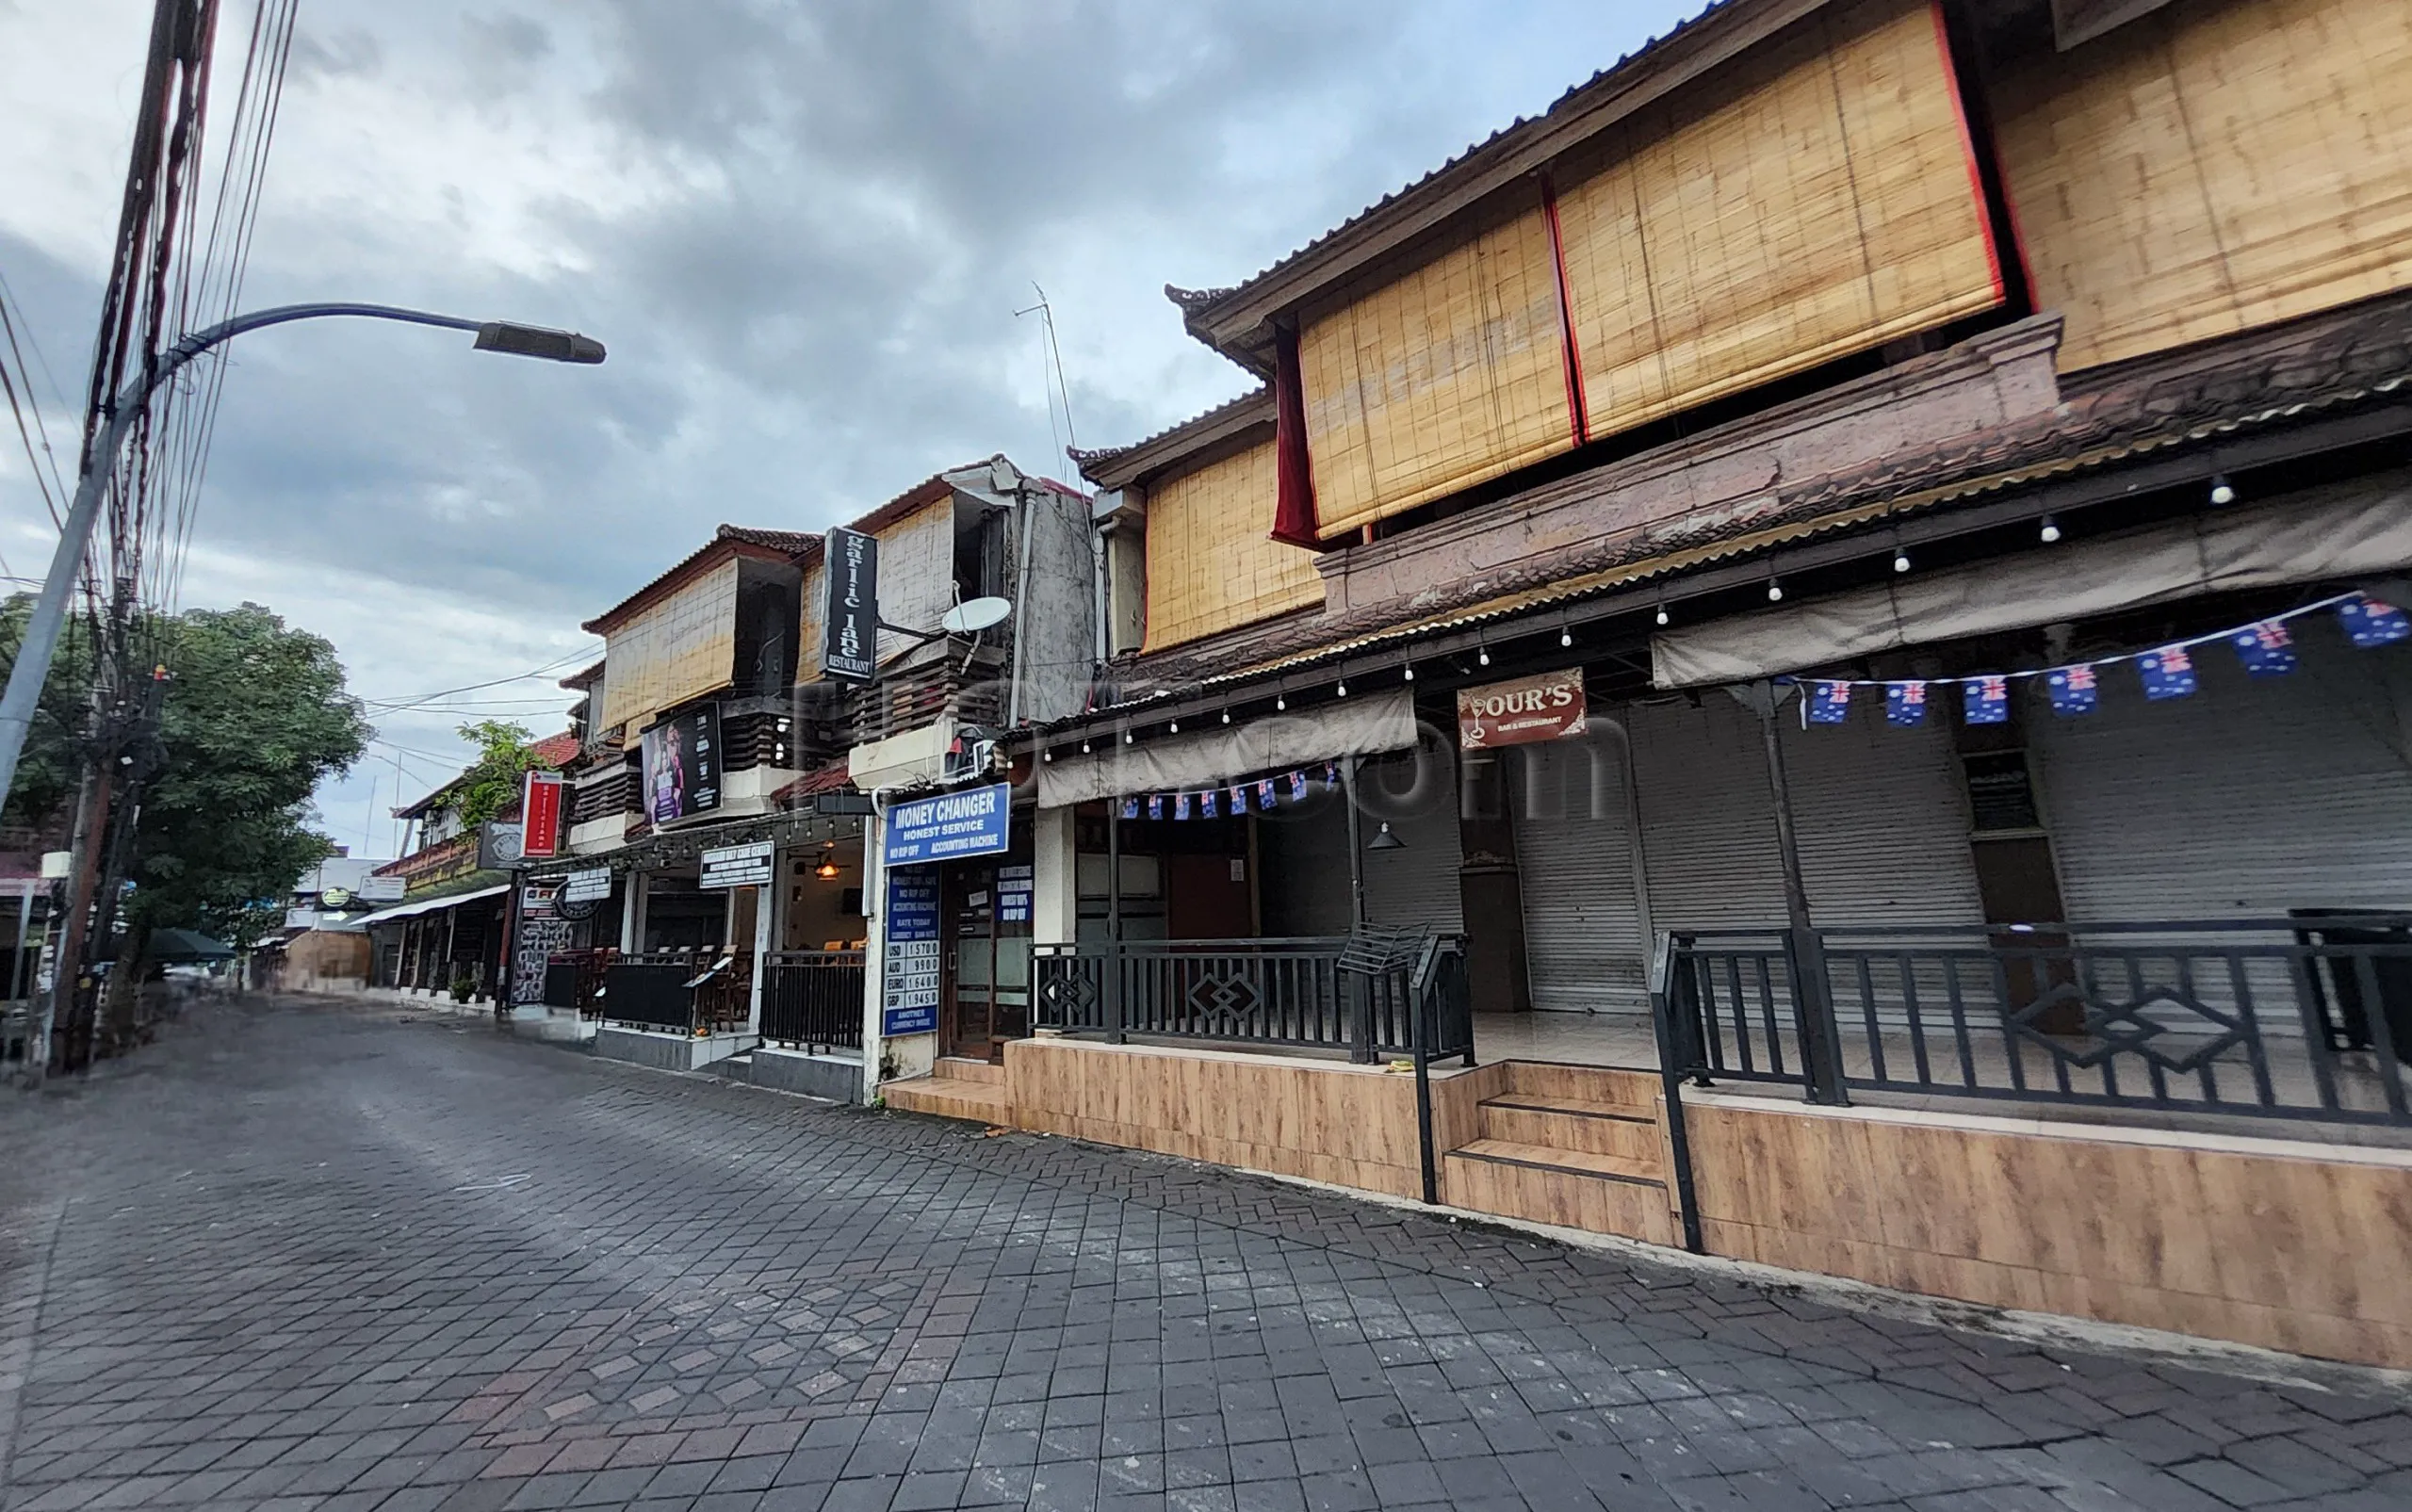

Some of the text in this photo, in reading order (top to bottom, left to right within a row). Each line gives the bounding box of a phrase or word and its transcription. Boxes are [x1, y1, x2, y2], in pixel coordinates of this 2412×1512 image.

[828, 654, 871, 675] RESTAURANT
[1498, 723, 1511, 732] BAR
[1519, 716, 1562, 730] RESTAURANT
[895, 791, 995, 830] MONEY CHANGER
[904, 820, 984, 841] HONEST SERVICE
[889, 834, 998, 859] NO RIP OFF ACCOUNTING MACHINE
[888, 942, 937, 956] USD 15700
[888, 959, 937, 973] AUD 9900
[888, 975, 937, 990] EURO 16400
[888, 992, 937, 1007] GBP 19450
[898, 1009, 925, 1019] ANOTHER
